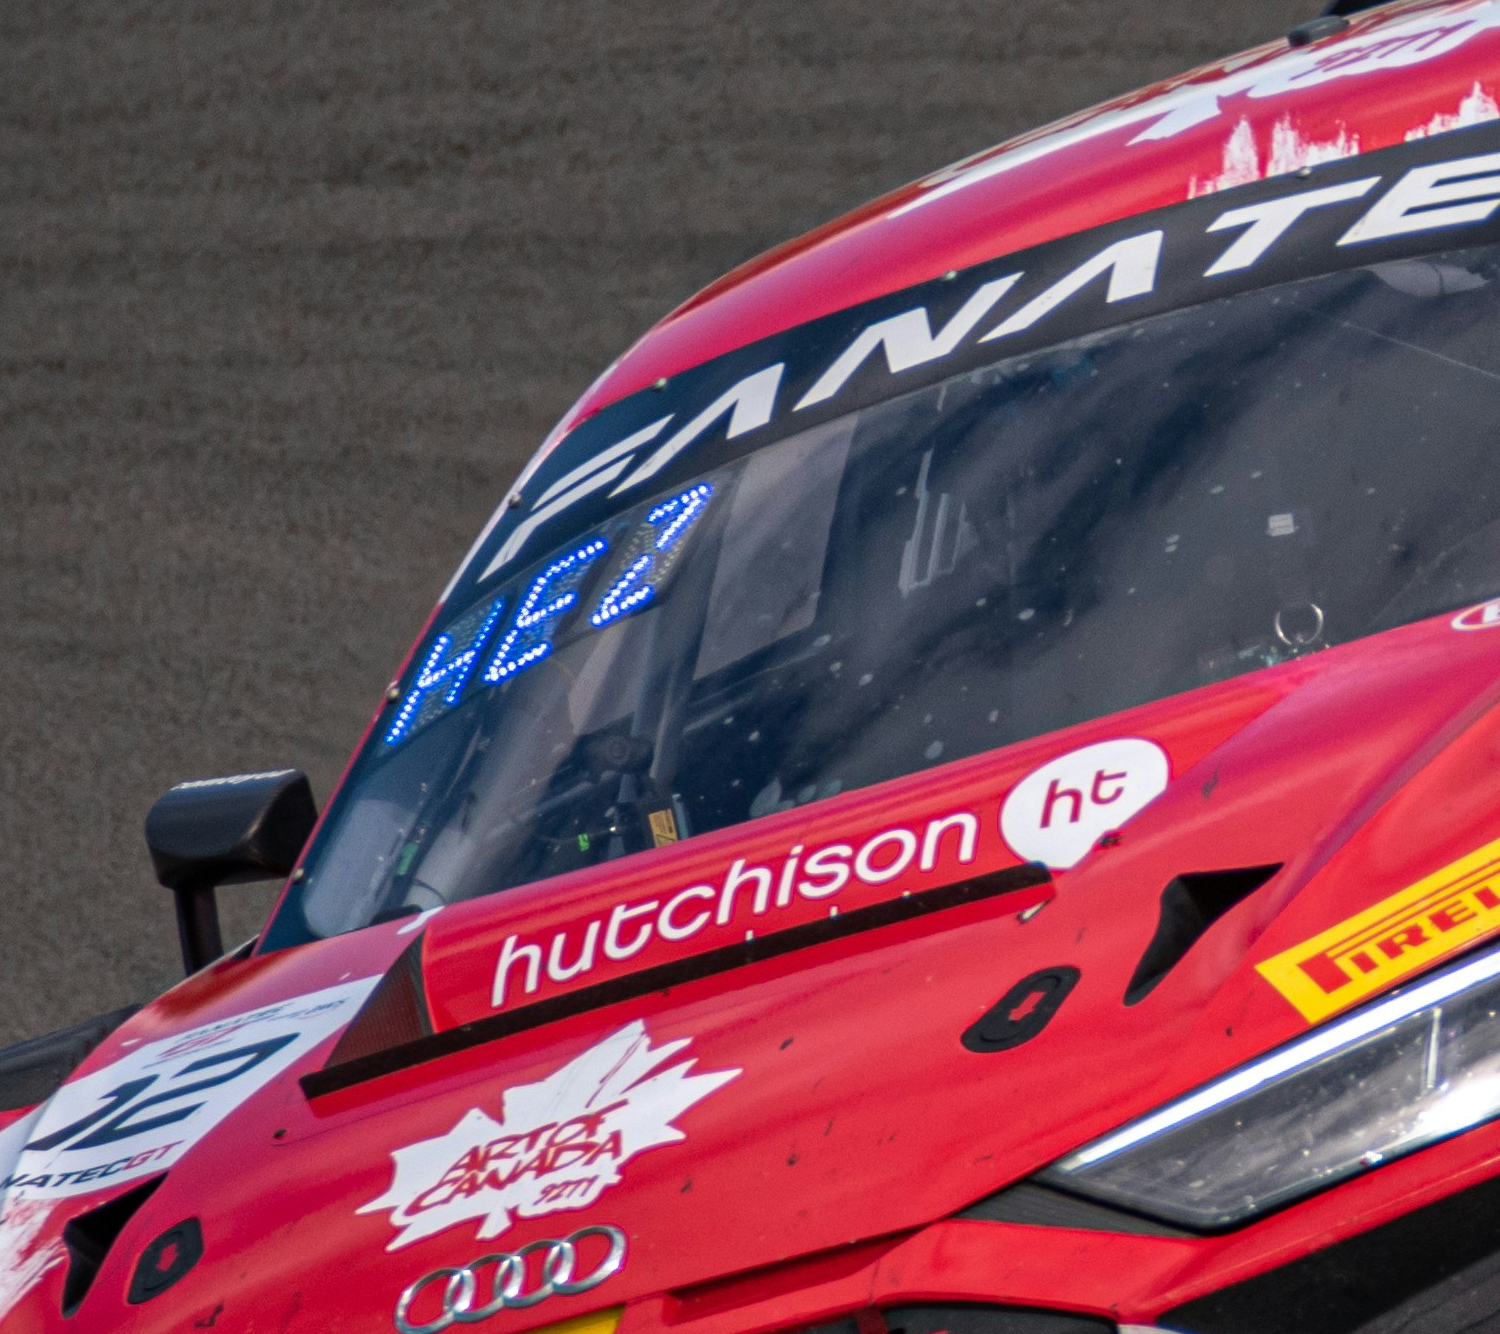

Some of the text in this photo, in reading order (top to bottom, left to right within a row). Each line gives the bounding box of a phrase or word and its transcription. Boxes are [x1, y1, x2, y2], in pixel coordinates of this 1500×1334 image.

[490, 768, 1128, 1008] hutchison ht
[20, 1032, 301, 1152] 12
[403, 1130, 622, 1217] CANADA
